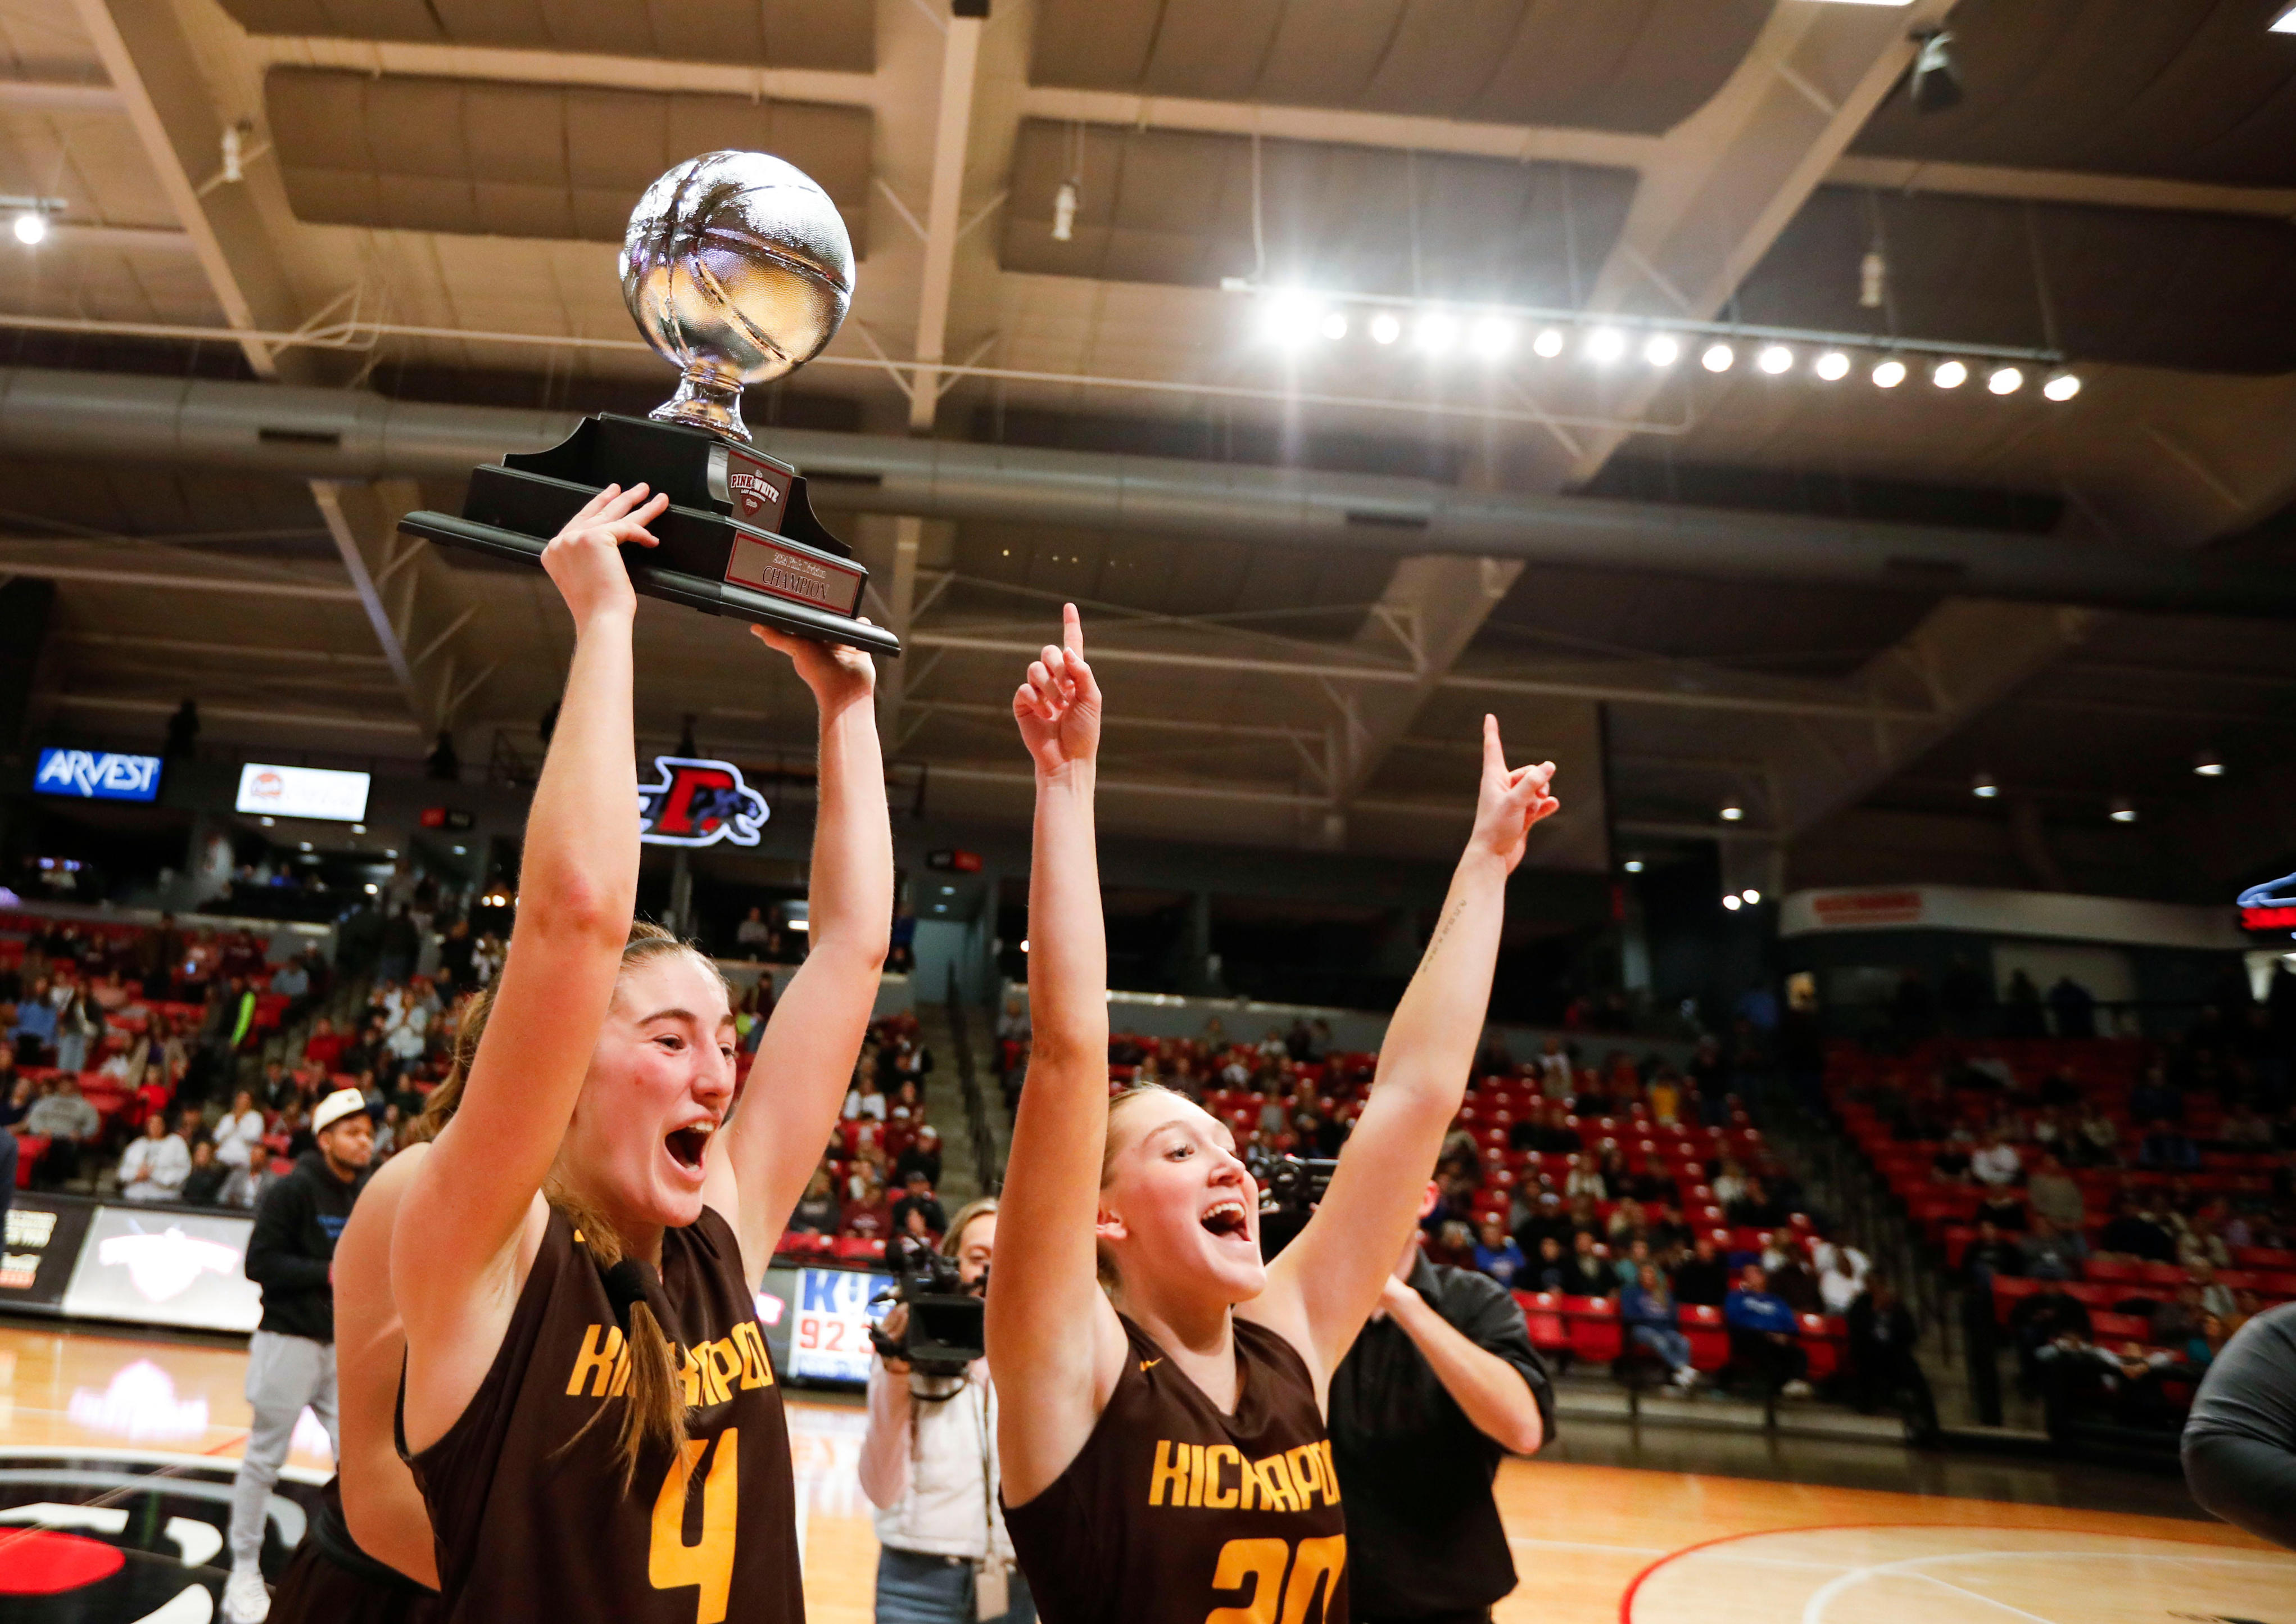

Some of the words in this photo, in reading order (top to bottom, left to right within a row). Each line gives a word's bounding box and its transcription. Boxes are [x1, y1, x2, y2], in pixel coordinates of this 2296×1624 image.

[730, 473, 754, 489] PINK
[754, 477, 780, 503] WHITE
[762, 565, 830, 601] CHAMPION
[38, 748, 160, 798] ARVEST
[565, 1320, 775, 1407] KIKAPOO
[1148, 1438, 1342, 1513] KICKAPO
[649, 1427, 739, 1624] 4
